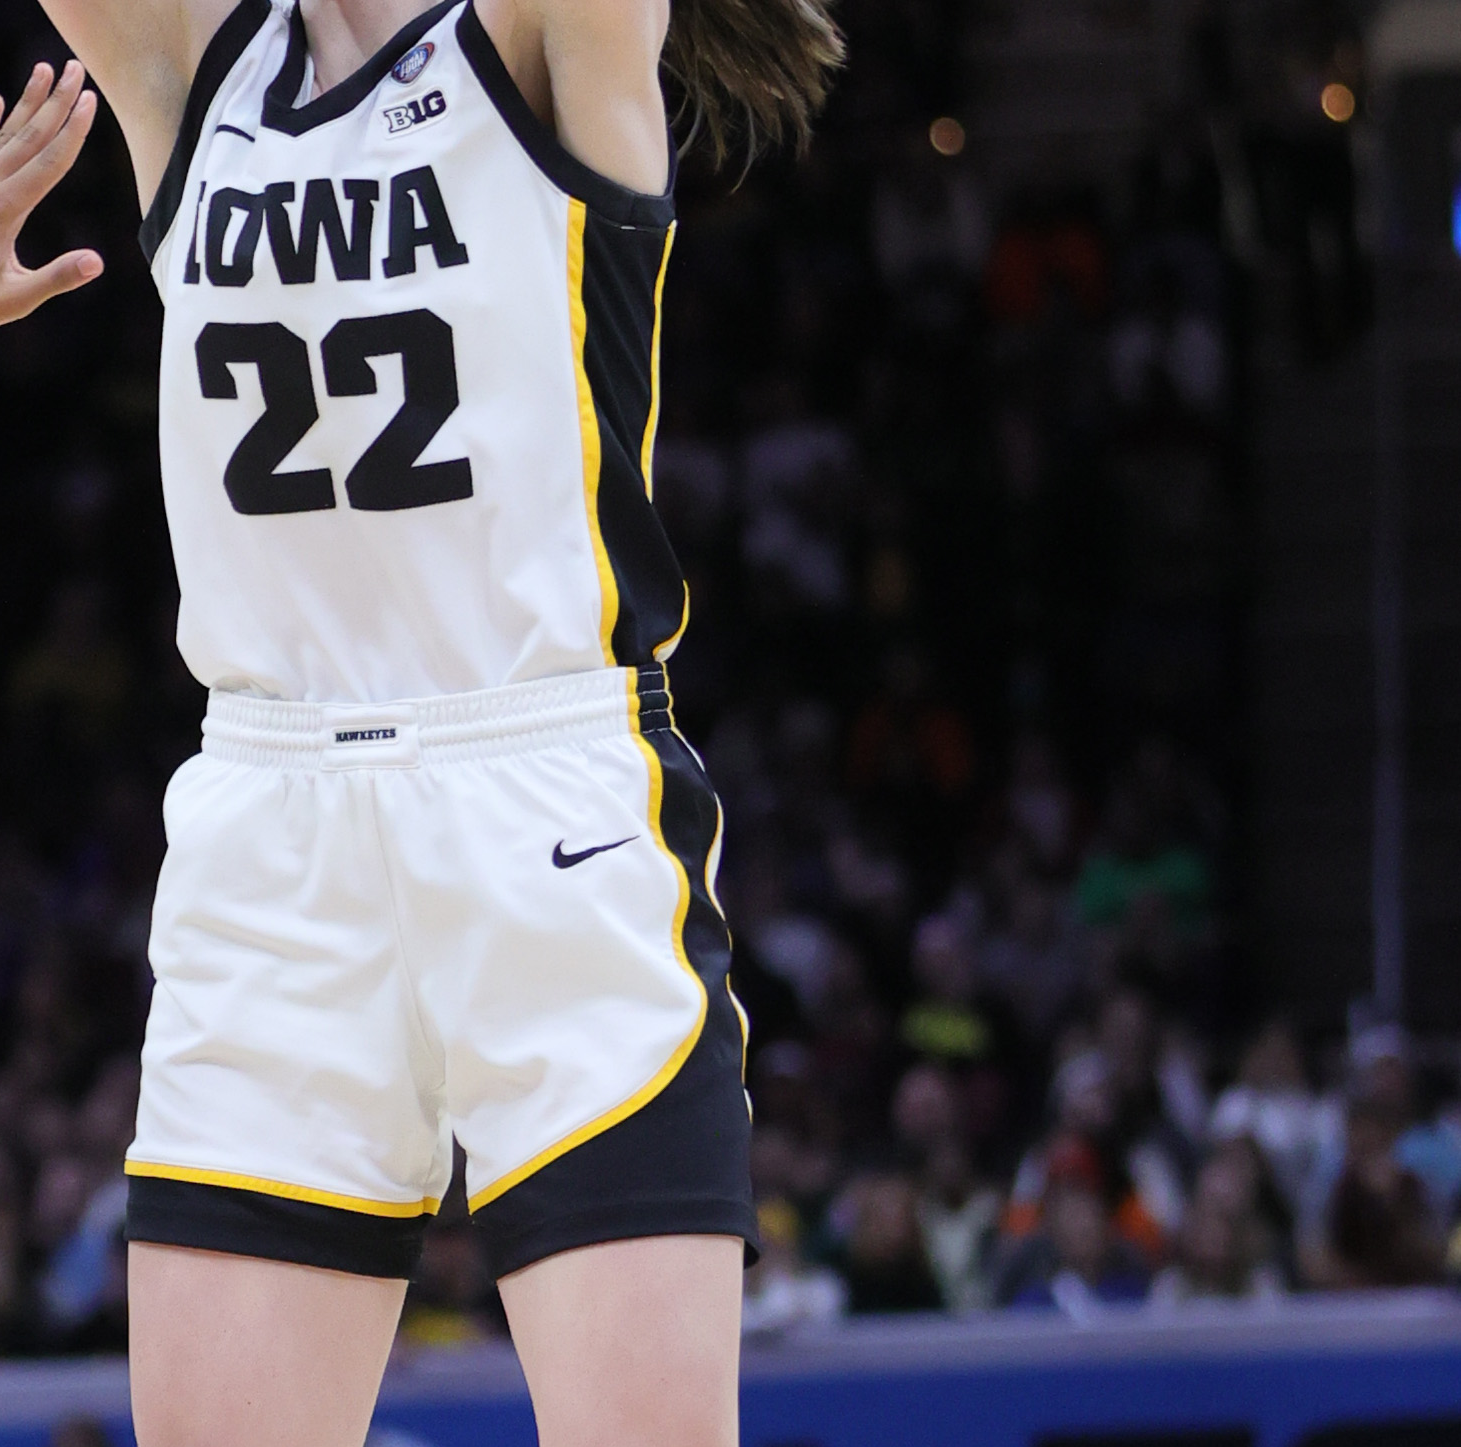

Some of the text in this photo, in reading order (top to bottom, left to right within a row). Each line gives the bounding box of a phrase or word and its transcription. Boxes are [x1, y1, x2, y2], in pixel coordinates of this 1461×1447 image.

[183, 165, 469, 287] IOWA
[195, 308, 473, 515] 22
[335, 728, 396, 743] HAWKEYES
